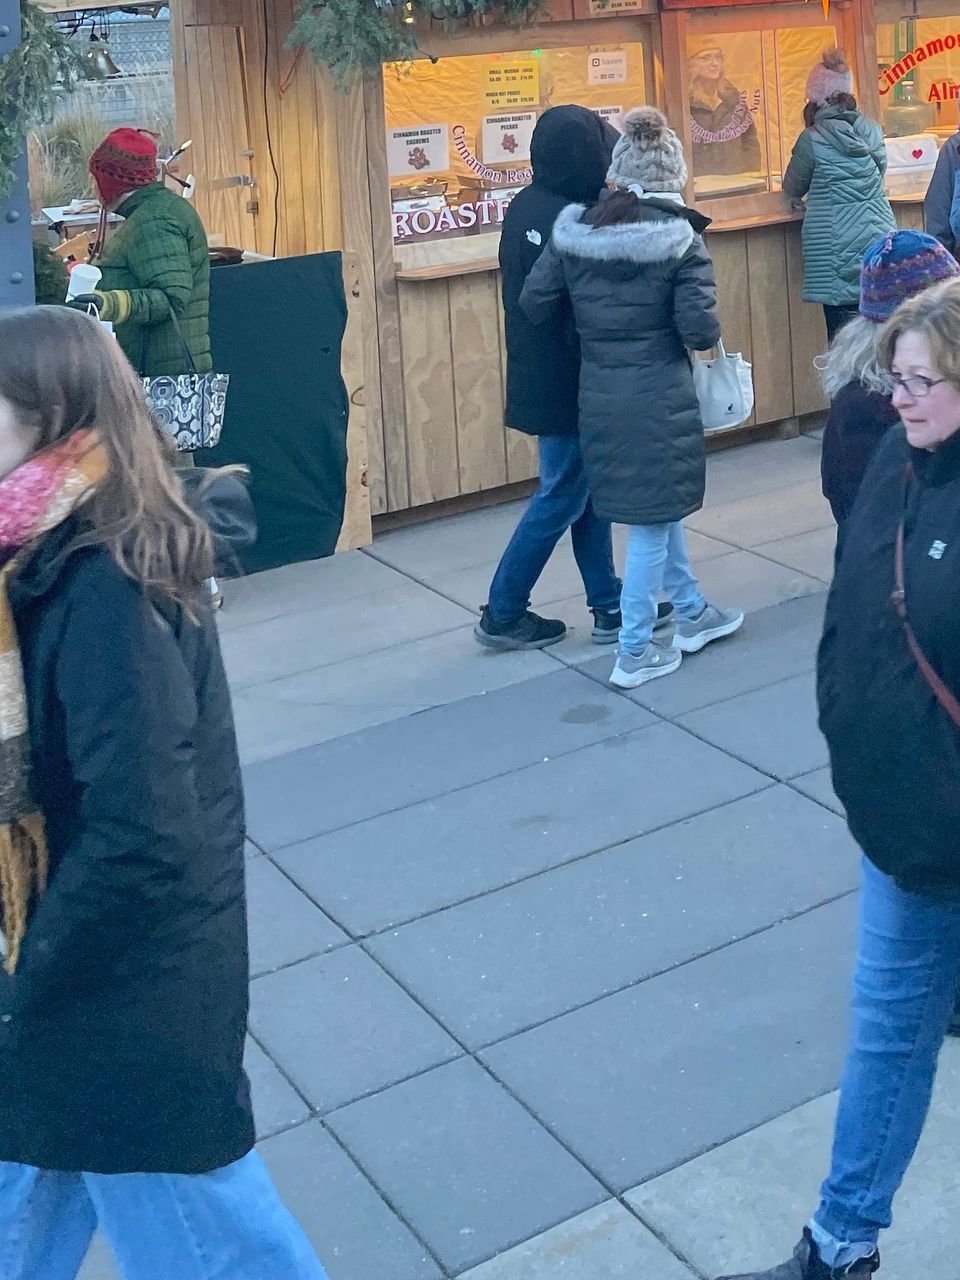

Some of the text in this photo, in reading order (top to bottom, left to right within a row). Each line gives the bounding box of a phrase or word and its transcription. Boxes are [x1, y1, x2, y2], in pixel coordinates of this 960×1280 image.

[420, 128, 441, 136] ROASTED
[452, 124, 502, 182] Cinnamon
[392, 198, 512, 238] ROAST
